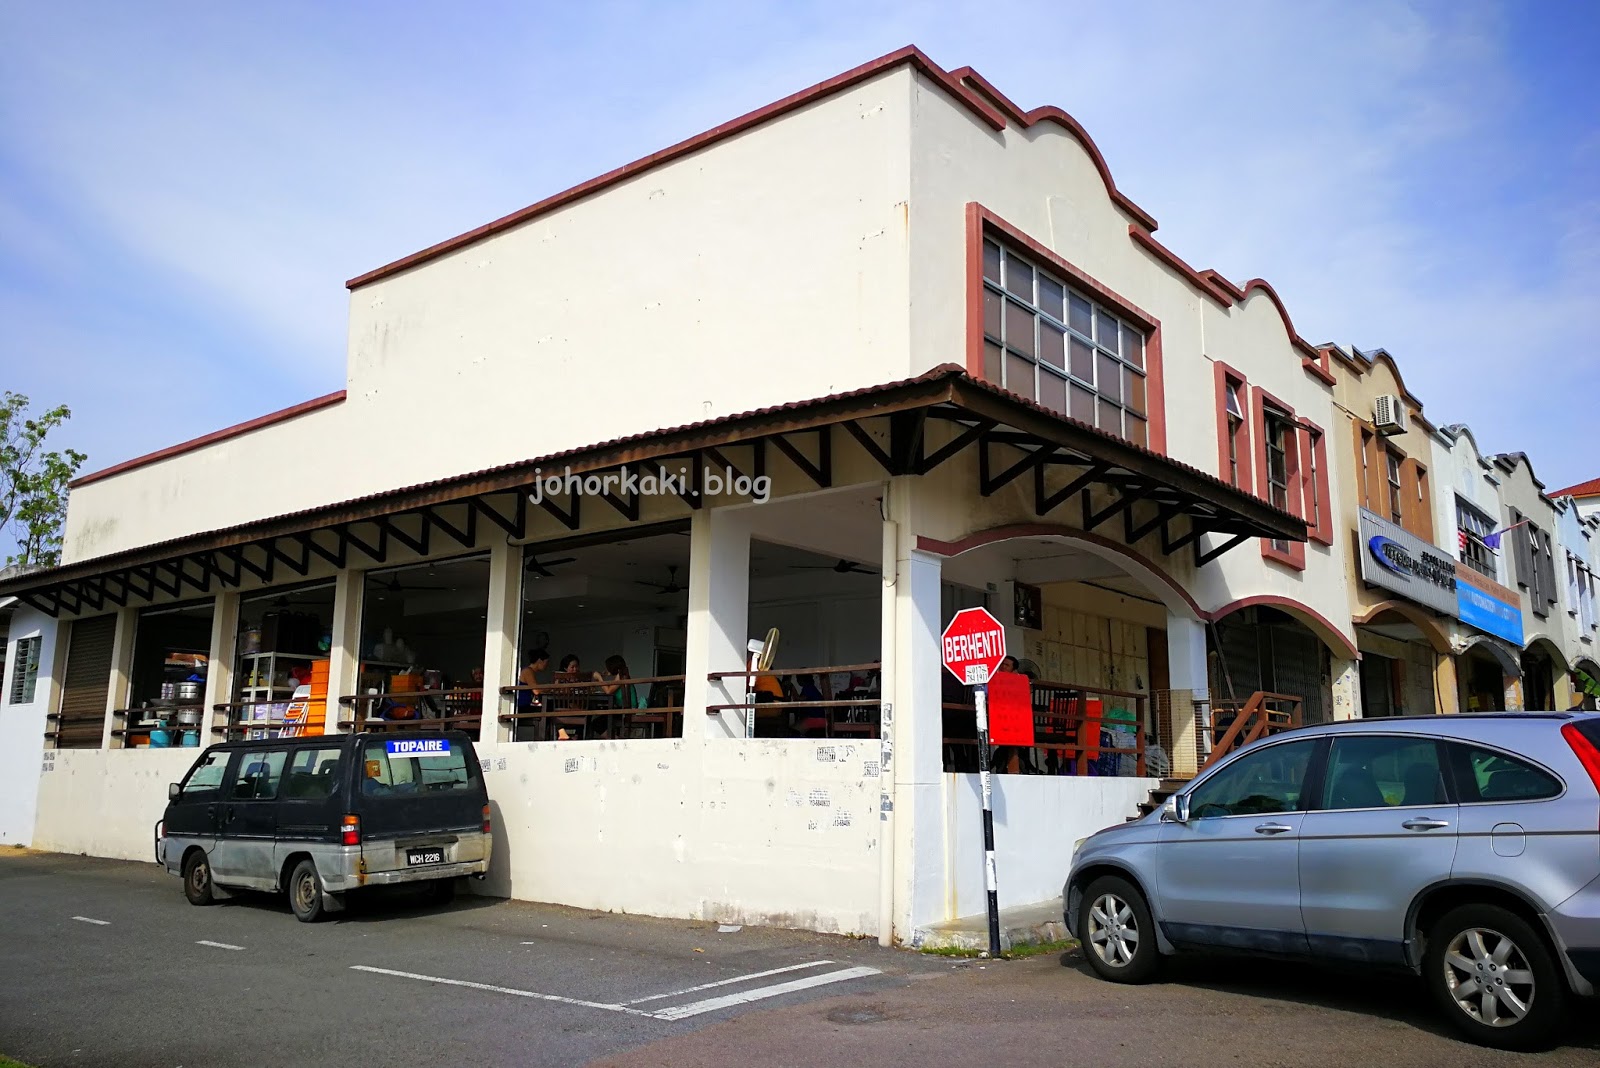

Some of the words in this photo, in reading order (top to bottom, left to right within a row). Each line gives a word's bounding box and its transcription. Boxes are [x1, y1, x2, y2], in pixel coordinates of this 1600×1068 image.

[945, 629, 1003, 663] BERHENTI
[393, 740, 443, 752] TOPAIRE
[410, 854, 424, 864] WCH
[424, 852, 440, 863] 2216
